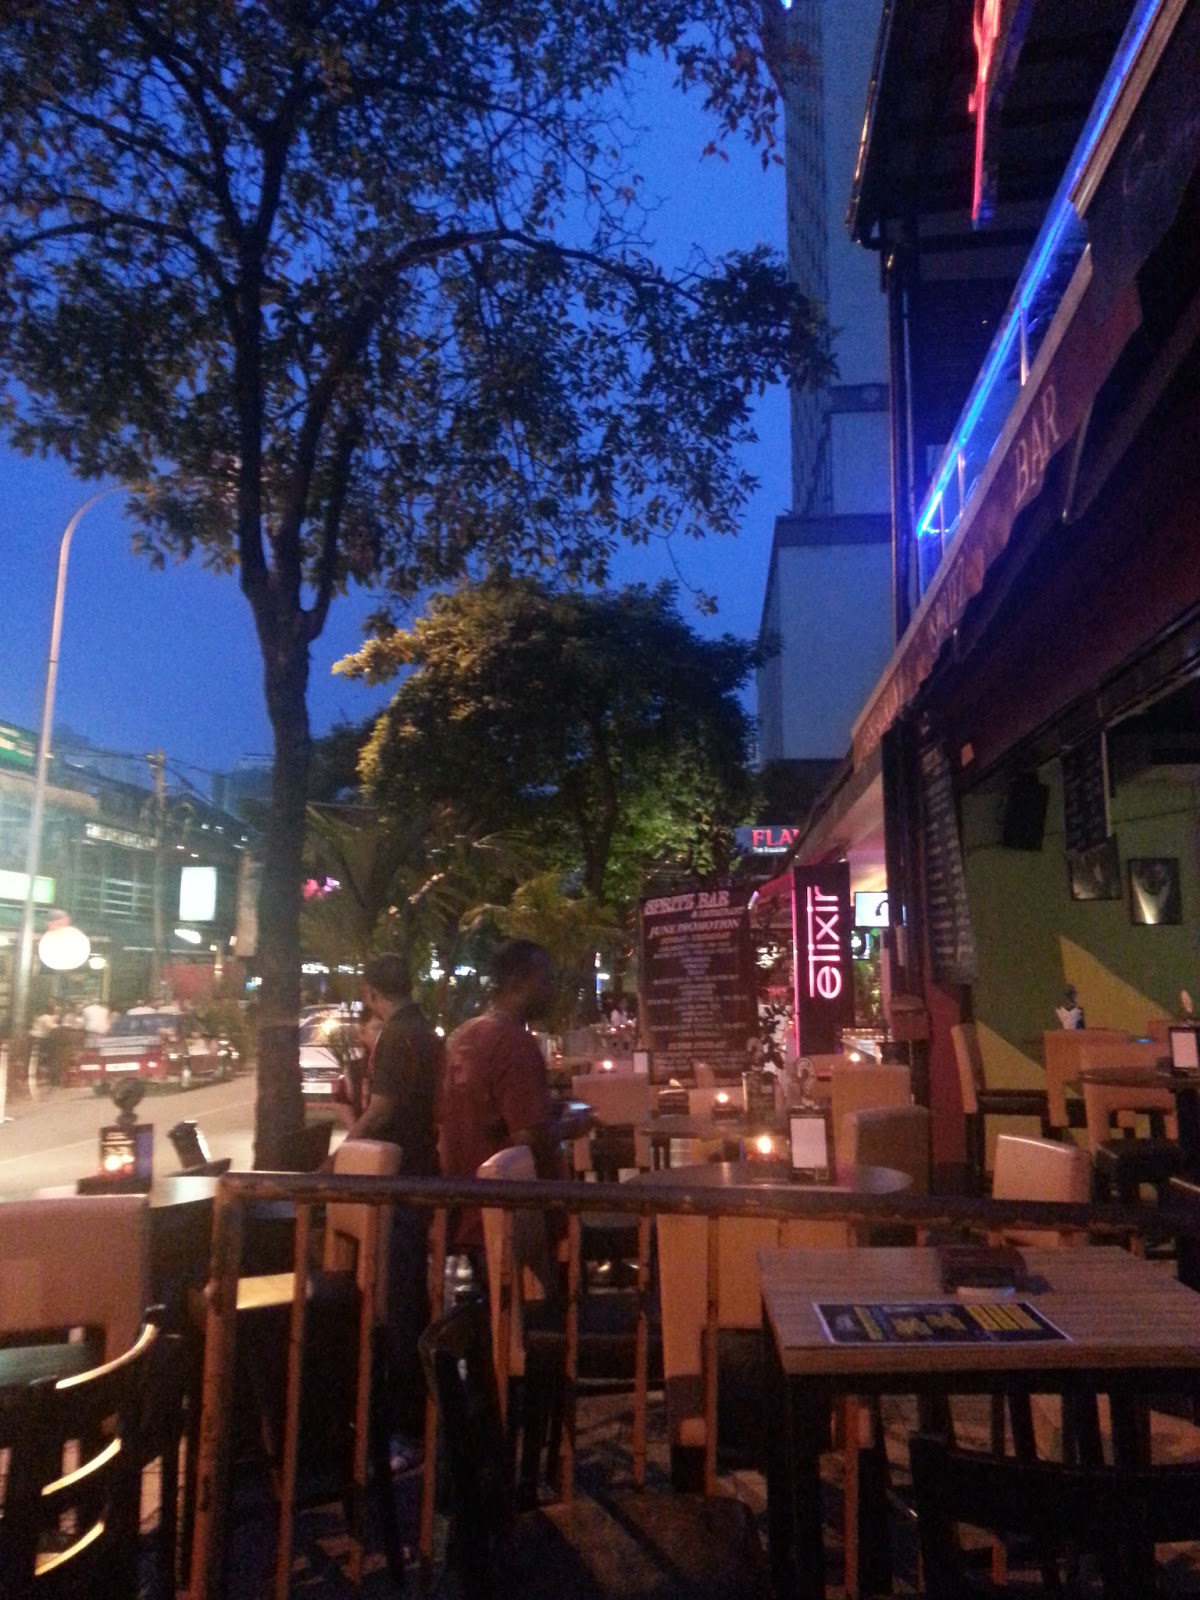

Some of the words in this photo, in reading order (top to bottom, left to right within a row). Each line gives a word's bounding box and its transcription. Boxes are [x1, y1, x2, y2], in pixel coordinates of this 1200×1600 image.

[1014, 384, 1060, 508] BAR
[697, 890, 730, 909] BAR
[807, 886, 842, 999] elixir
